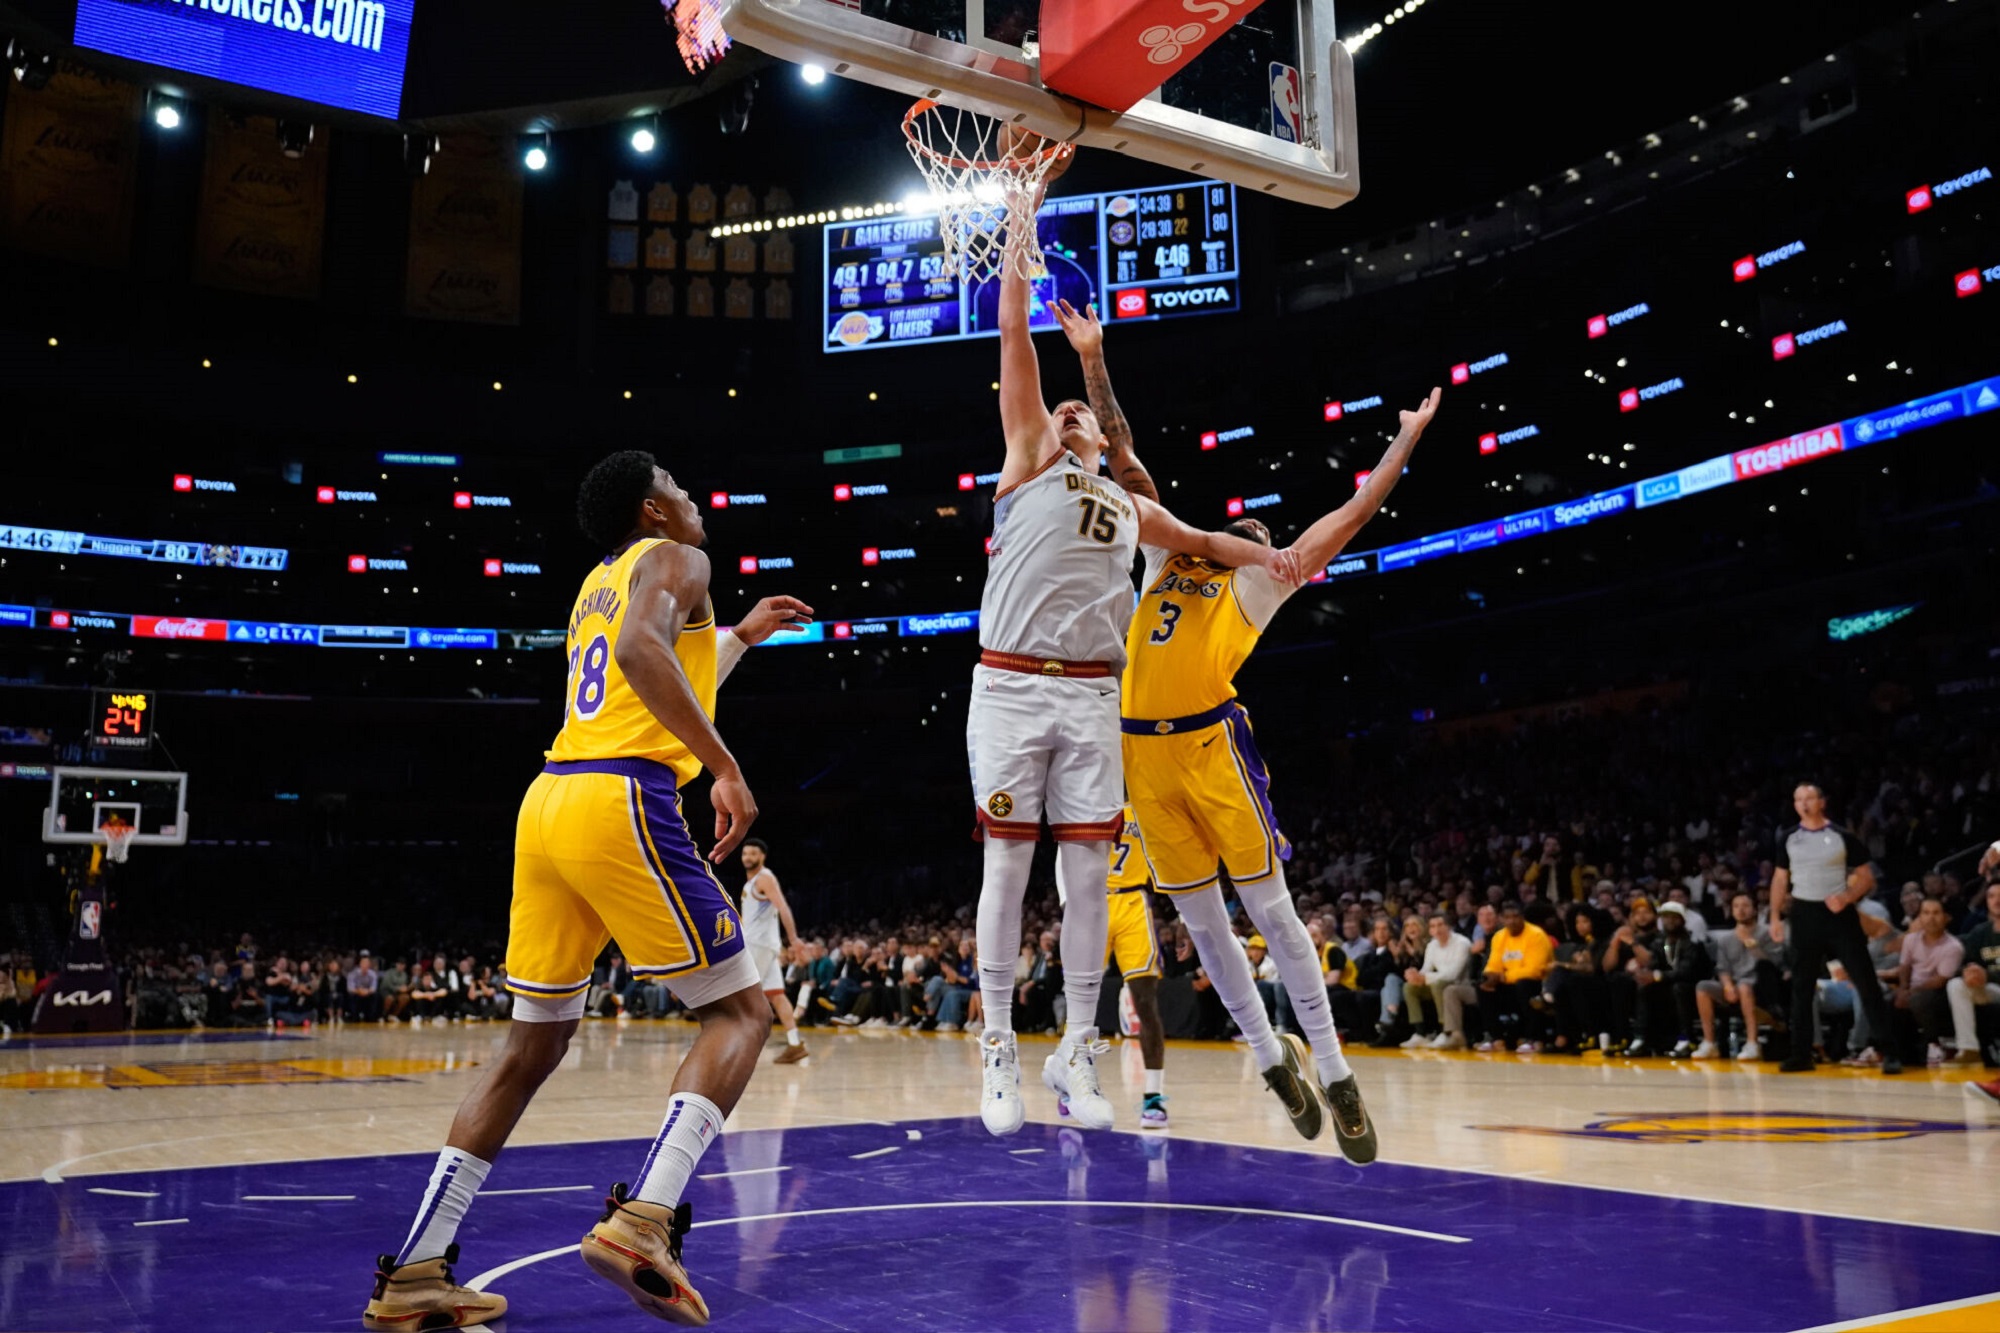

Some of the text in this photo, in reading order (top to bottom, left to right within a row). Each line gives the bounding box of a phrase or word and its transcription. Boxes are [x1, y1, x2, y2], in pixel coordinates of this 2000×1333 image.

[1276, 123, 1292, 141] NBA
[1932, 166, 1992, 198] TOYOTA
[1141, 197, 1156, 214] 34
[1157, 194, 1172, 212] 39
[1211, 188, 1224, 206] 81
[1212, 212, 1228, 232] 80
[854, 219, 934, 246] GAME STATS
[1154, 244, 1190, 269] 4:46
[1756, 240, 1806, 270] TOYOTA
[832, 264, 869, 289] 49.1
[875, 259, 914, 286] 94.7
[1151, 286, 1230, 308] TOYOTA
[889, 308, 903, 323] LOS
[1607, 303, 1650, 326] TOYOTA
[889, 319, 933, 340] LAKERS
[1796, 320, 1847, 346] TOYOTA
[1468, 353, 1509, 375] TOYOTA
[1638, 378, 1684, 402] TOYOTA
[1342, 396, 1383, 414] TOYOTA
[1217, 426, 1254, 442] TOYOTA
[1497, 425, 1540, 445] TOYOTA
[1736, 430, 1839, 476] TOSHIBA
[194, 478, 236, 492] TOYOTA
[850, 485, 888, 497] TOYOTA
[1645, 463, 1728, 499] UCLA Health
[336, 490, 378, 503] TOYOTA
[472, 496, 511, 507] TOYOTA
[728, 494, 767, 505] TOYOTA
[1243, 493, 1282, 509] TOYOTA
[1553, 493, 1626, 525] Spectrum
[1078, 496, 1118, 545] 15
[1503, 516, 1542, 535] ULTRA
[0, 528, 53, 549] 4:46
[91, 540, 143, 555] Nuggets
[164, 543, 189, 560] 80
[879, 549, 916, 560] TOYOTA
[368, 559, 407, 571] TOYOTA
[502, 562, 541, 575] TOYOTA
[757, 557, 794, 569] TOYOTA
[1326, 559, 1367, 576] TOYOTA
[569, 586, 621, 640] HACHIMURA
[1148, 600, 1183, 646] 3
[72, 615, 116, 629] TOYOTA
[255, 626, 315, 641] DELTA
[851, 616, 971, 635] TOYOTA Spectrum
[432, 633, 488, 644] crypto.com
[103, 707, 142, 736] 24
[110, 736, 148, 747] TISSOT
[15, 765, 48, 777] TOYOTA
